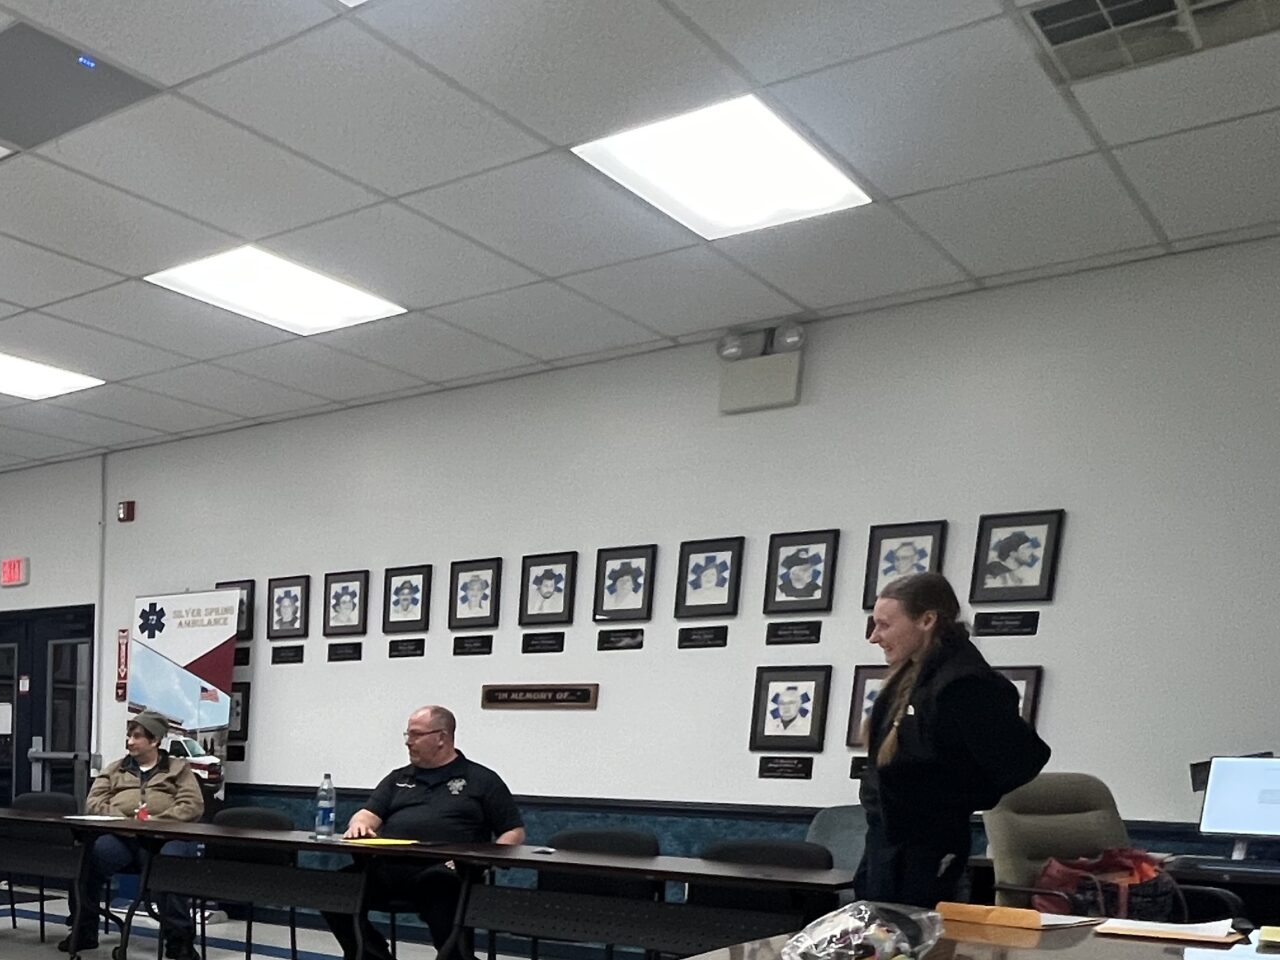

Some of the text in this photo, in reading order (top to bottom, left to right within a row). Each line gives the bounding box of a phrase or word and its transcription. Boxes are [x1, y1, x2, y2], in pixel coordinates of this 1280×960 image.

[172, 606, 235, 619] SILVER SPRING
[177, 617, 229, 629] AMBULANCE
[510, 691, 553, 700] MEMORY
